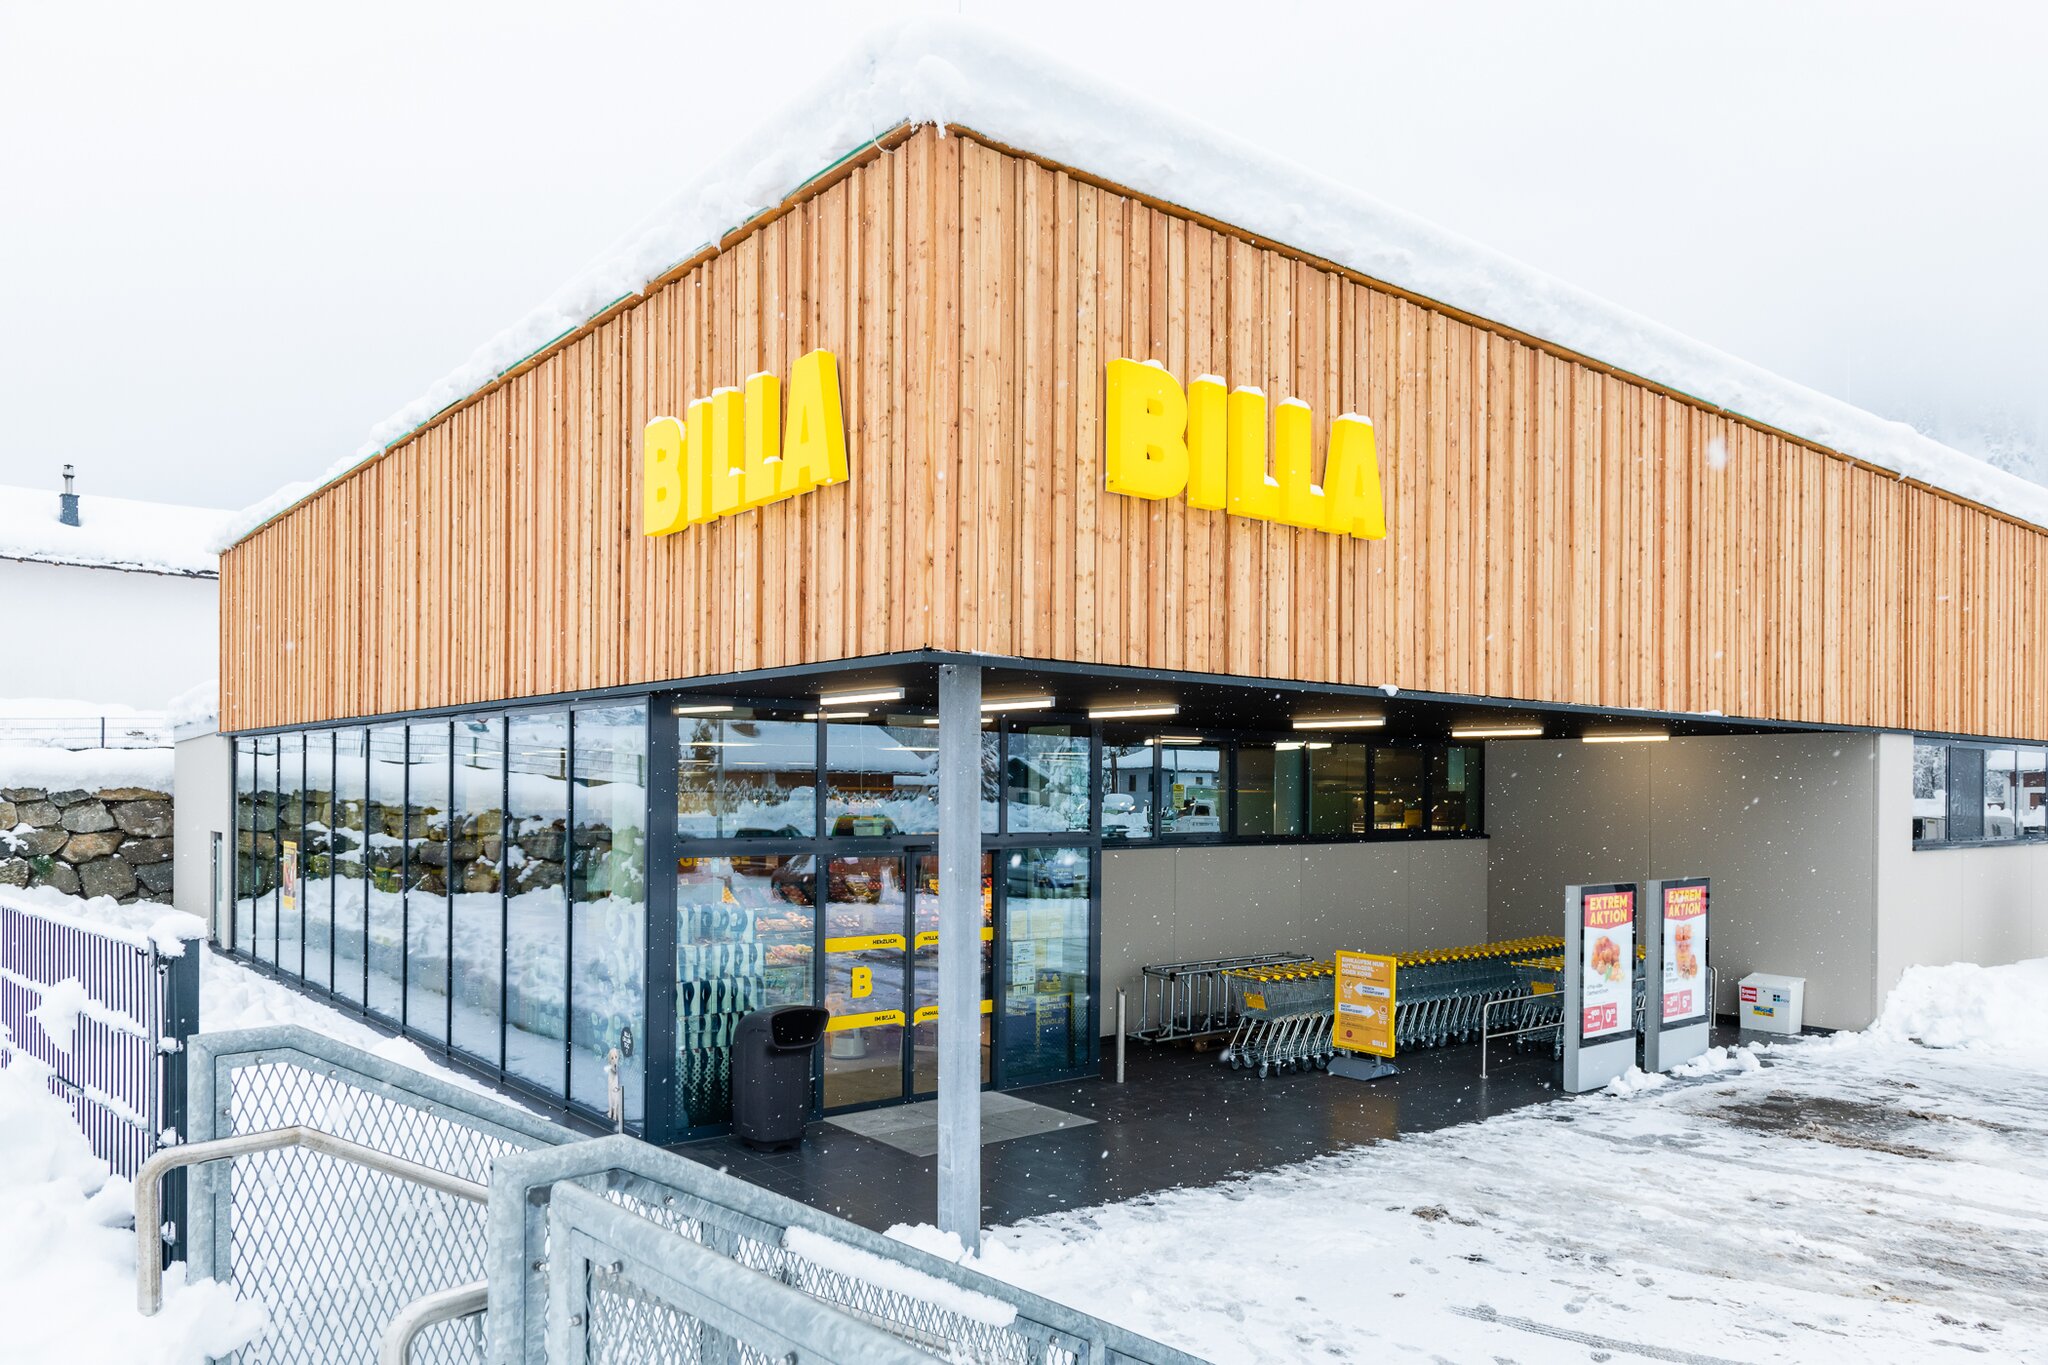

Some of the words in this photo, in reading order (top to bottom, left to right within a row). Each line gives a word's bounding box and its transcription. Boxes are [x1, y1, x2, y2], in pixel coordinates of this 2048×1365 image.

[644, 349, 849, 537] BILLA
[1106, 358, 1386, 540] BILLA
[1589, 894, 1628, 911] EXTREM
[1668, 889, 1702, 904] EXTREM
[1590, 908, 1628, 925] AKTION
[1668, 902, 1701, 917] AKTION
[851, 966, 873, 999] B
